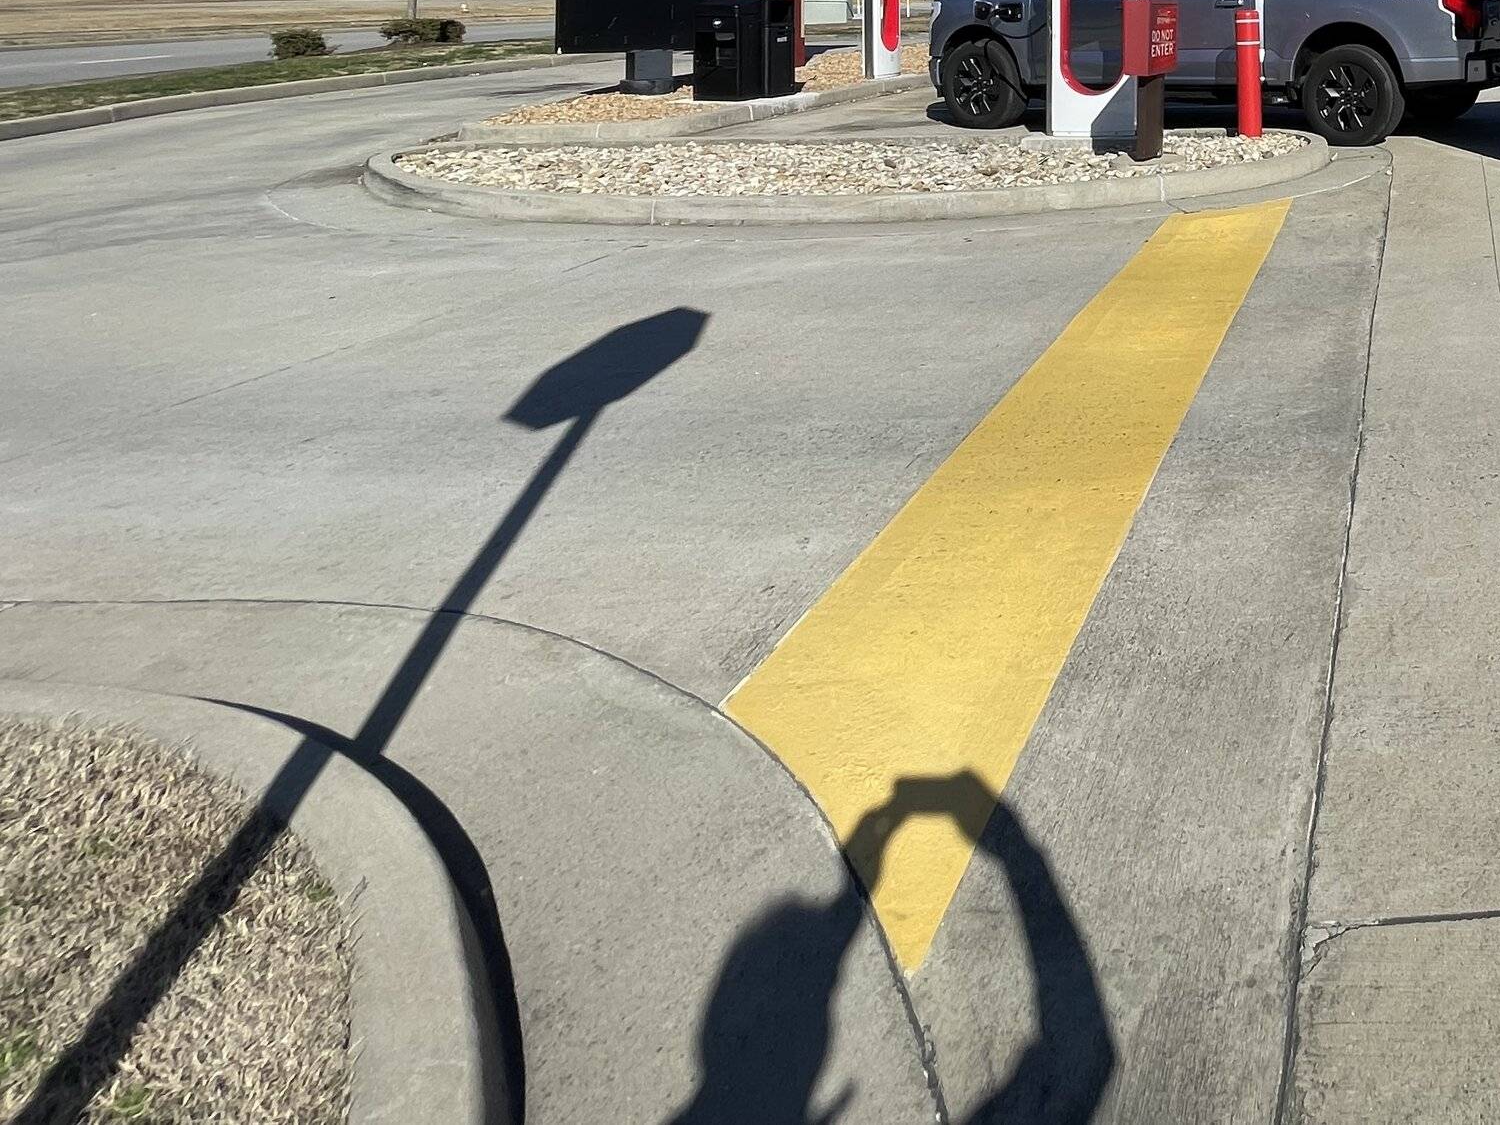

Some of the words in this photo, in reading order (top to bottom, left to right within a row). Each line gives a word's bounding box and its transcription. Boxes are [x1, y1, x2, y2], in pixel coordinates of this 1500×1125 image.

[1151, 29, 1161, 42] DO
[1161, 28, 1174, 41] NOT
[1151, 42, 1174, 58] ENTER
